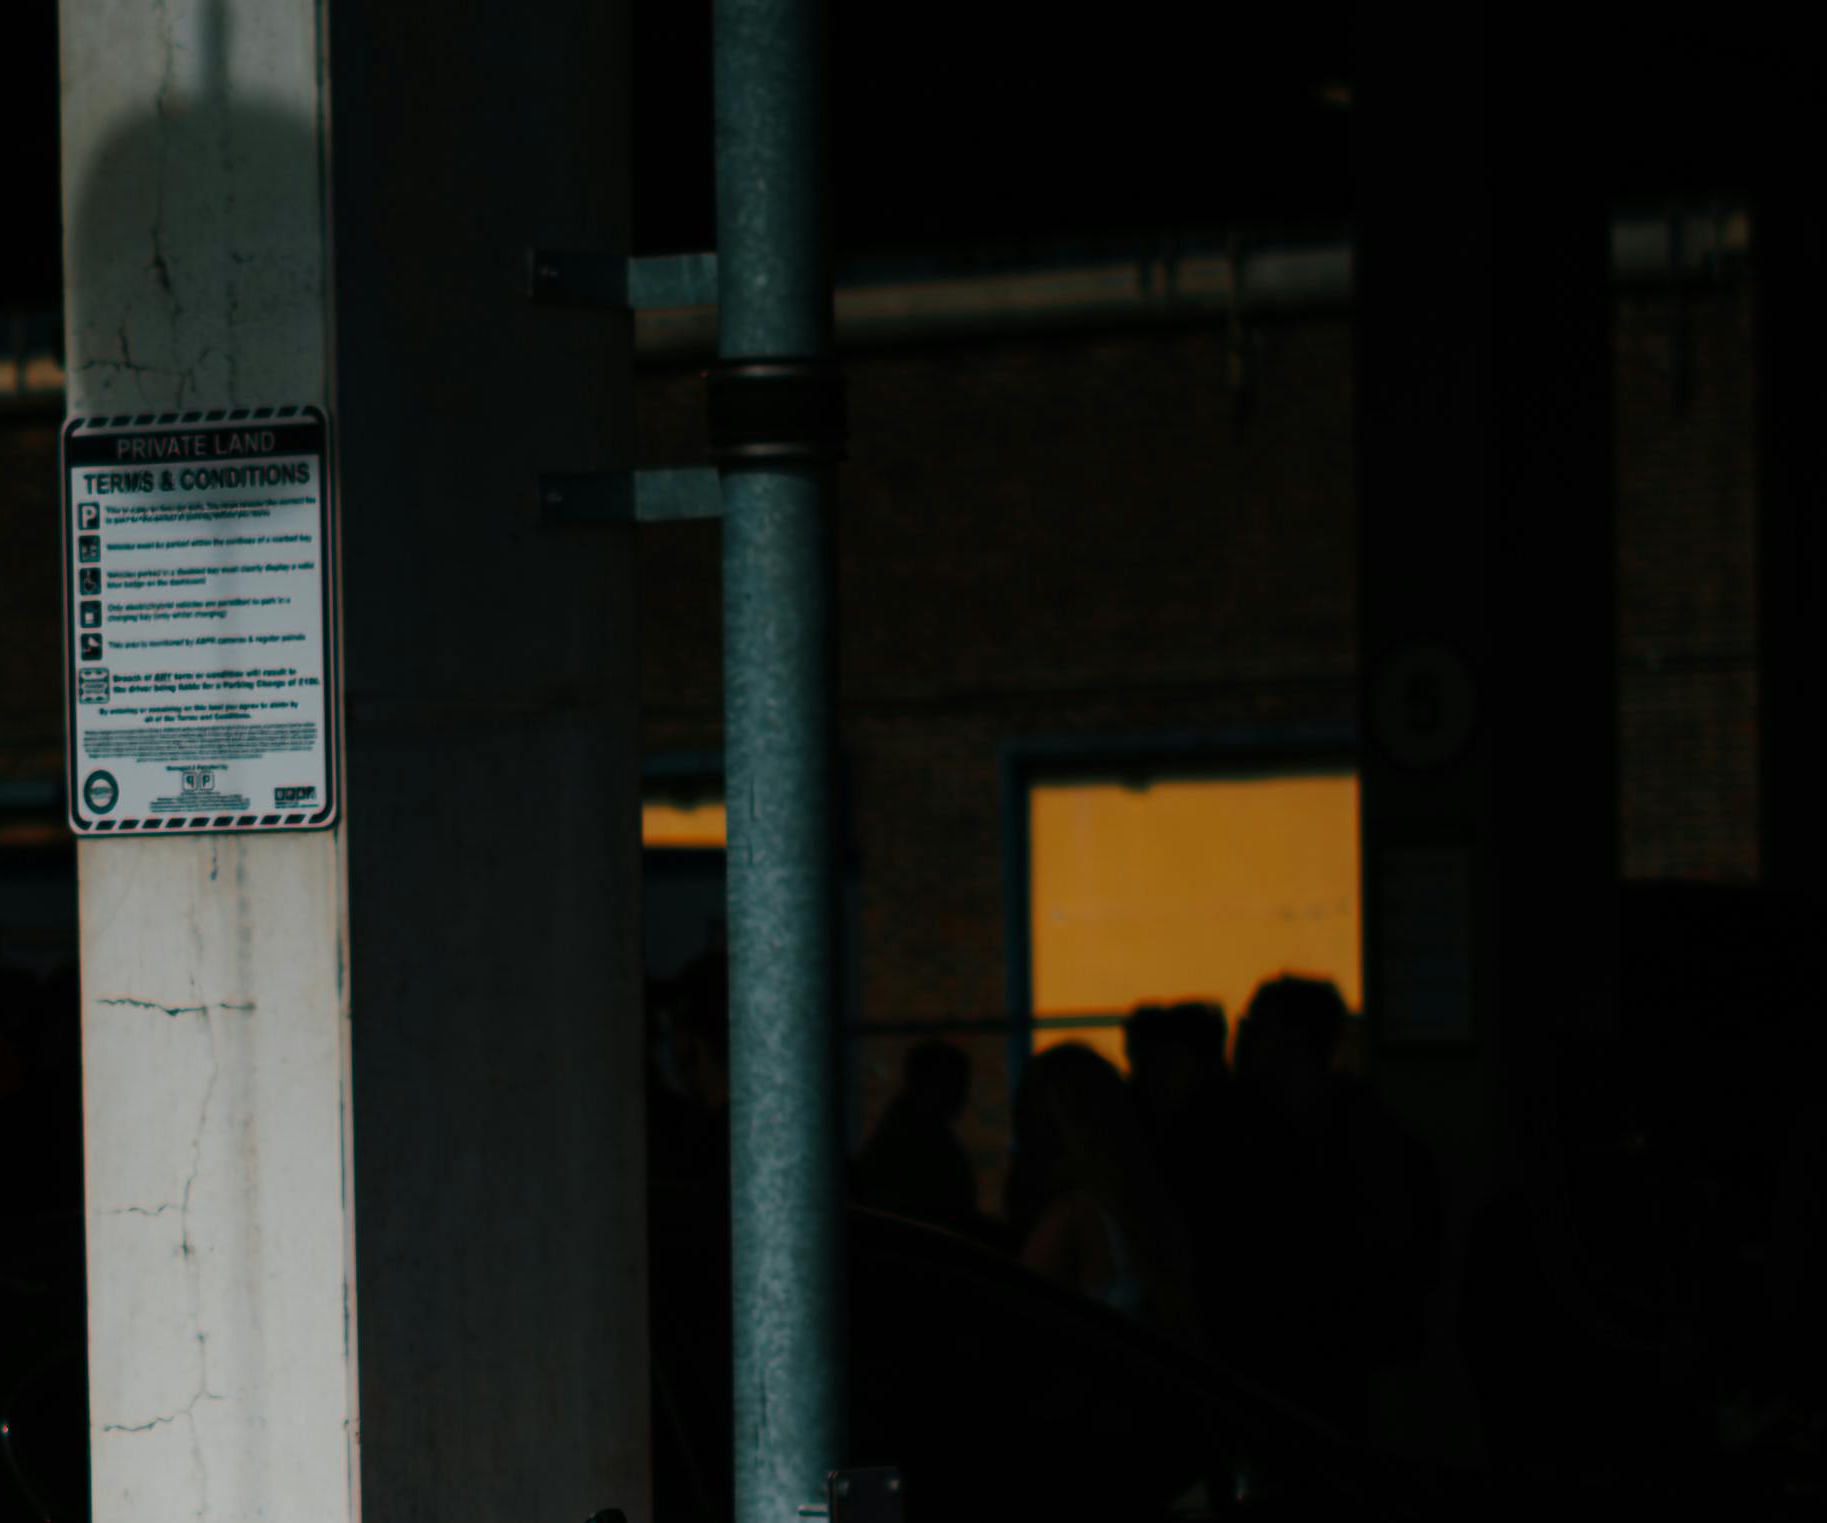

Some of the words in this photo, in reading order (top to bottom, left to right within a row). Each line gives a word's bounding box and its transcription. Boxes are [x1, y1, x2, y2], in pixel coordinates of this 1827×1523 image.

[117, 435, 208, 460] PRIVATE
[215, 430, 276, 455] LAND
[84, 469, 154, 495] TERMS
[160, 468, 175, 491] &
[180, 462, 310, 490] CONDITIONS
